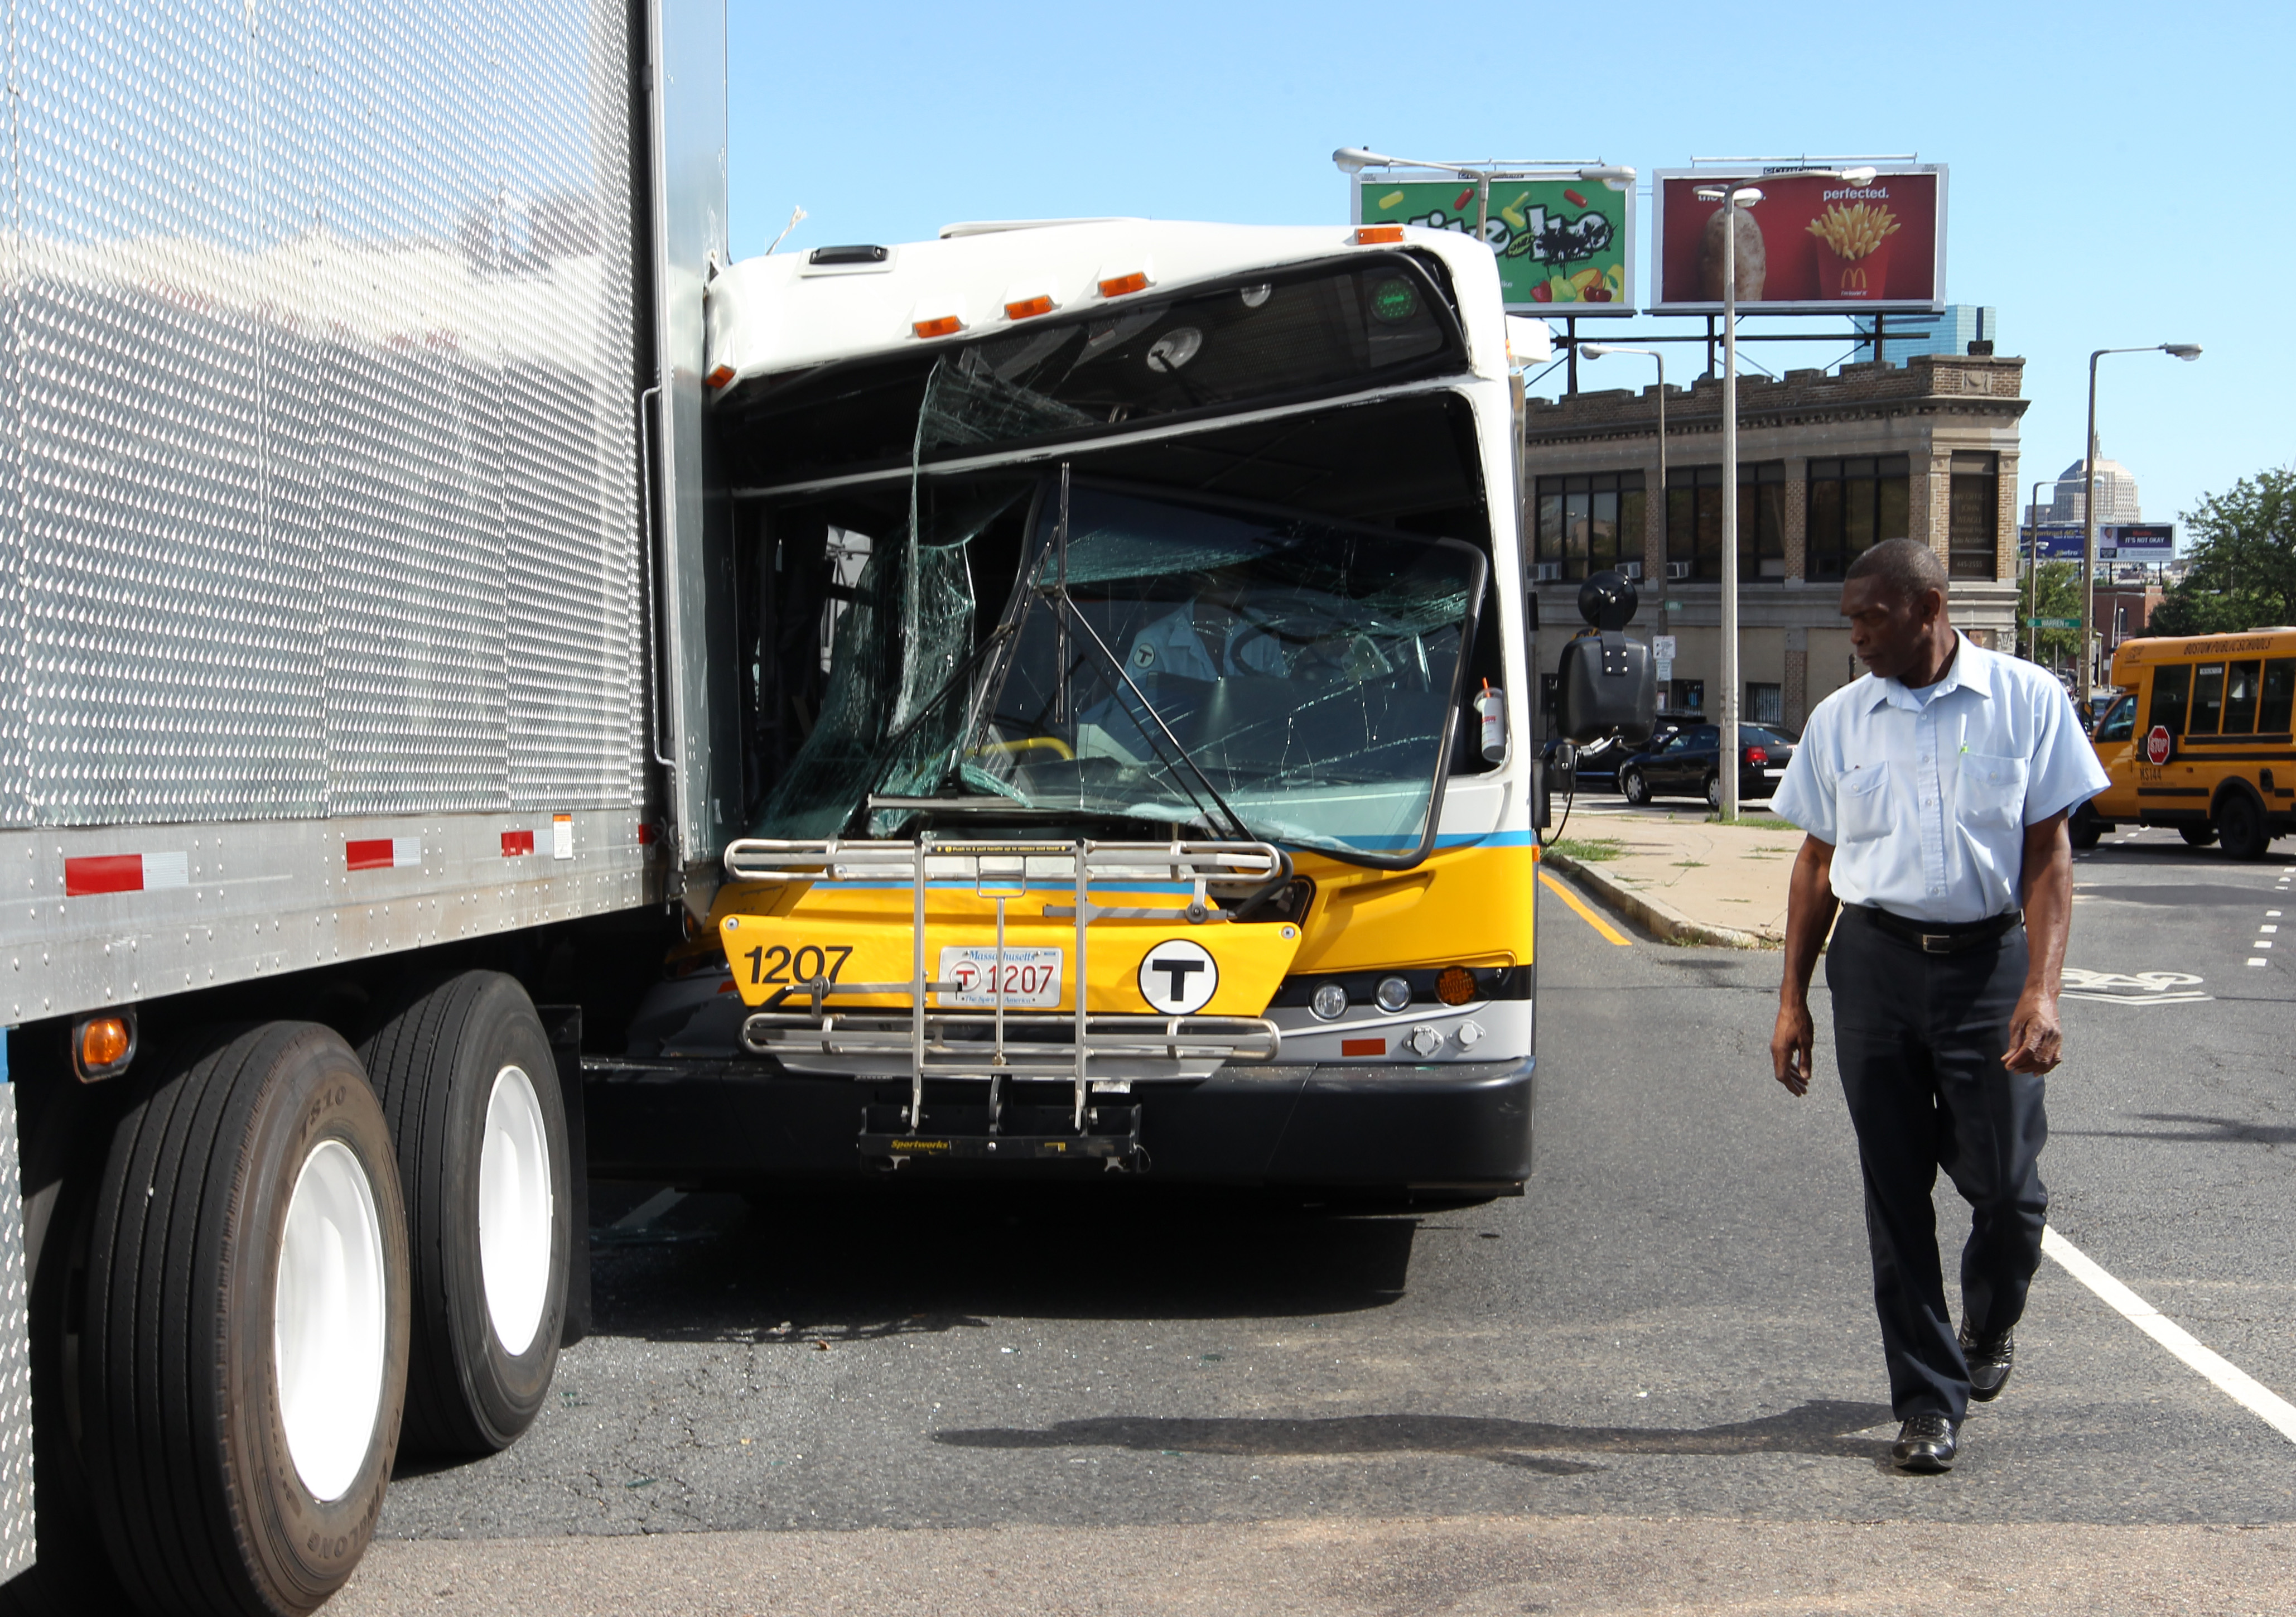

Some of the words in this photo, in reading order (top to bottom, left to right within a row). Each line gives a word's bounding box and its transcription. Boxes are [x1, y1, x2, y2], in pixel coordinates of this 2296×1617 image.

[1824, 187, 1889, 201] perfected.
[2041, 619, 2065, 627] WARREN
[2183, 642, 2210, 655] BOSTON
[2237, 637, 2274, 652] SCHOOLS
[1139, 649, 1152, 663] T
[2150, 738, 2168, 753] STOP
[969, 950, 1035, 961] Massahusetts
[744, 945, 853, 984] 1207
[956, 970, 975, 986] T
[986, 965, 1054, 994] 1207
[1152, 959, 1205, 1002] T
[891, 1139, 948, 1150] Sportworks
